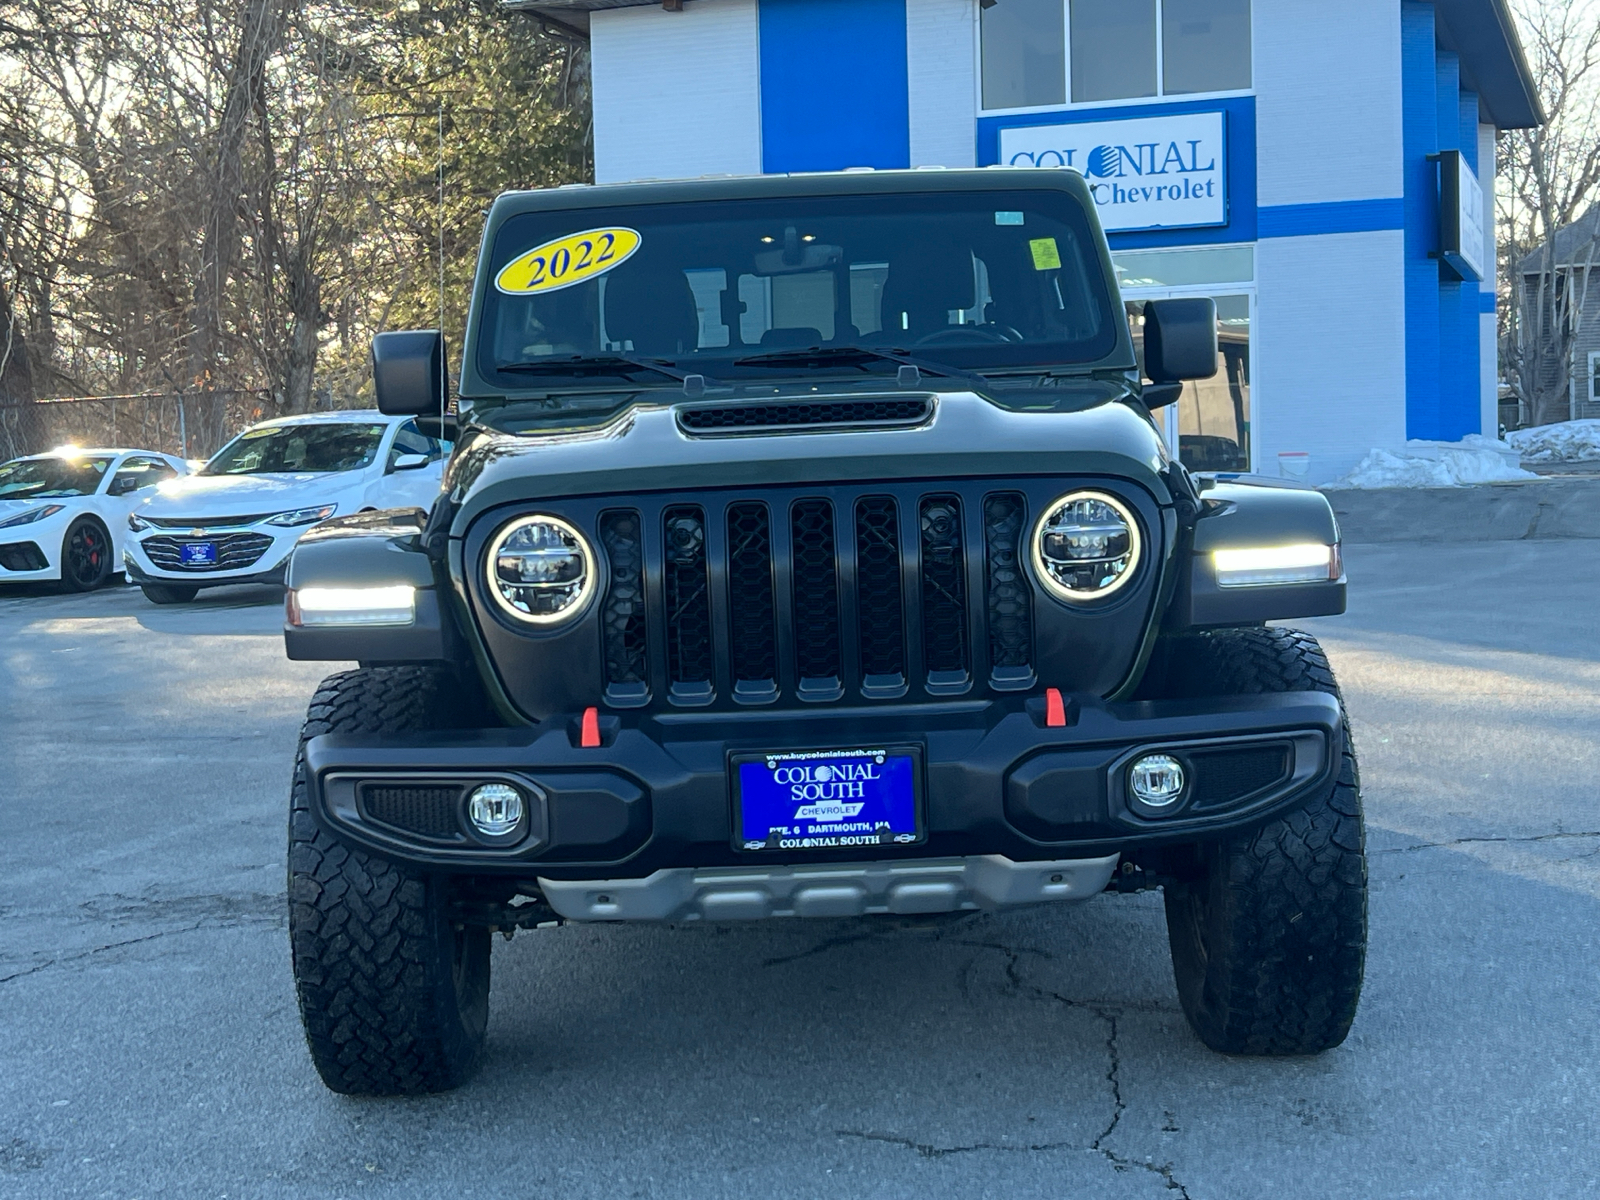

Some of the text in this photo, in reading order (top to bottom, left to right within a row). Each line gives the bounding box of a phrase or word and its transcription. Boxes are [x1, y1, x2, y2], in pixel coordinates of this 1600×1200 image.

[1095, 178, 1216, 205] Chevrolet
[526, 232, 615, 288] 2022
[766, 750, 886, 761] www.buycolonialsouth.com
[774, 763, 880, 784] COLONIAL
[791, 782, 865, 801] SOUTH
[801, 806, 857, 816] CHEVROLET
[793, 826, 800, 835] 6
[808, 822, 873, 834] DARTMOUTH,
[779, 835, 880, 849] COLONIAL SOUTH
